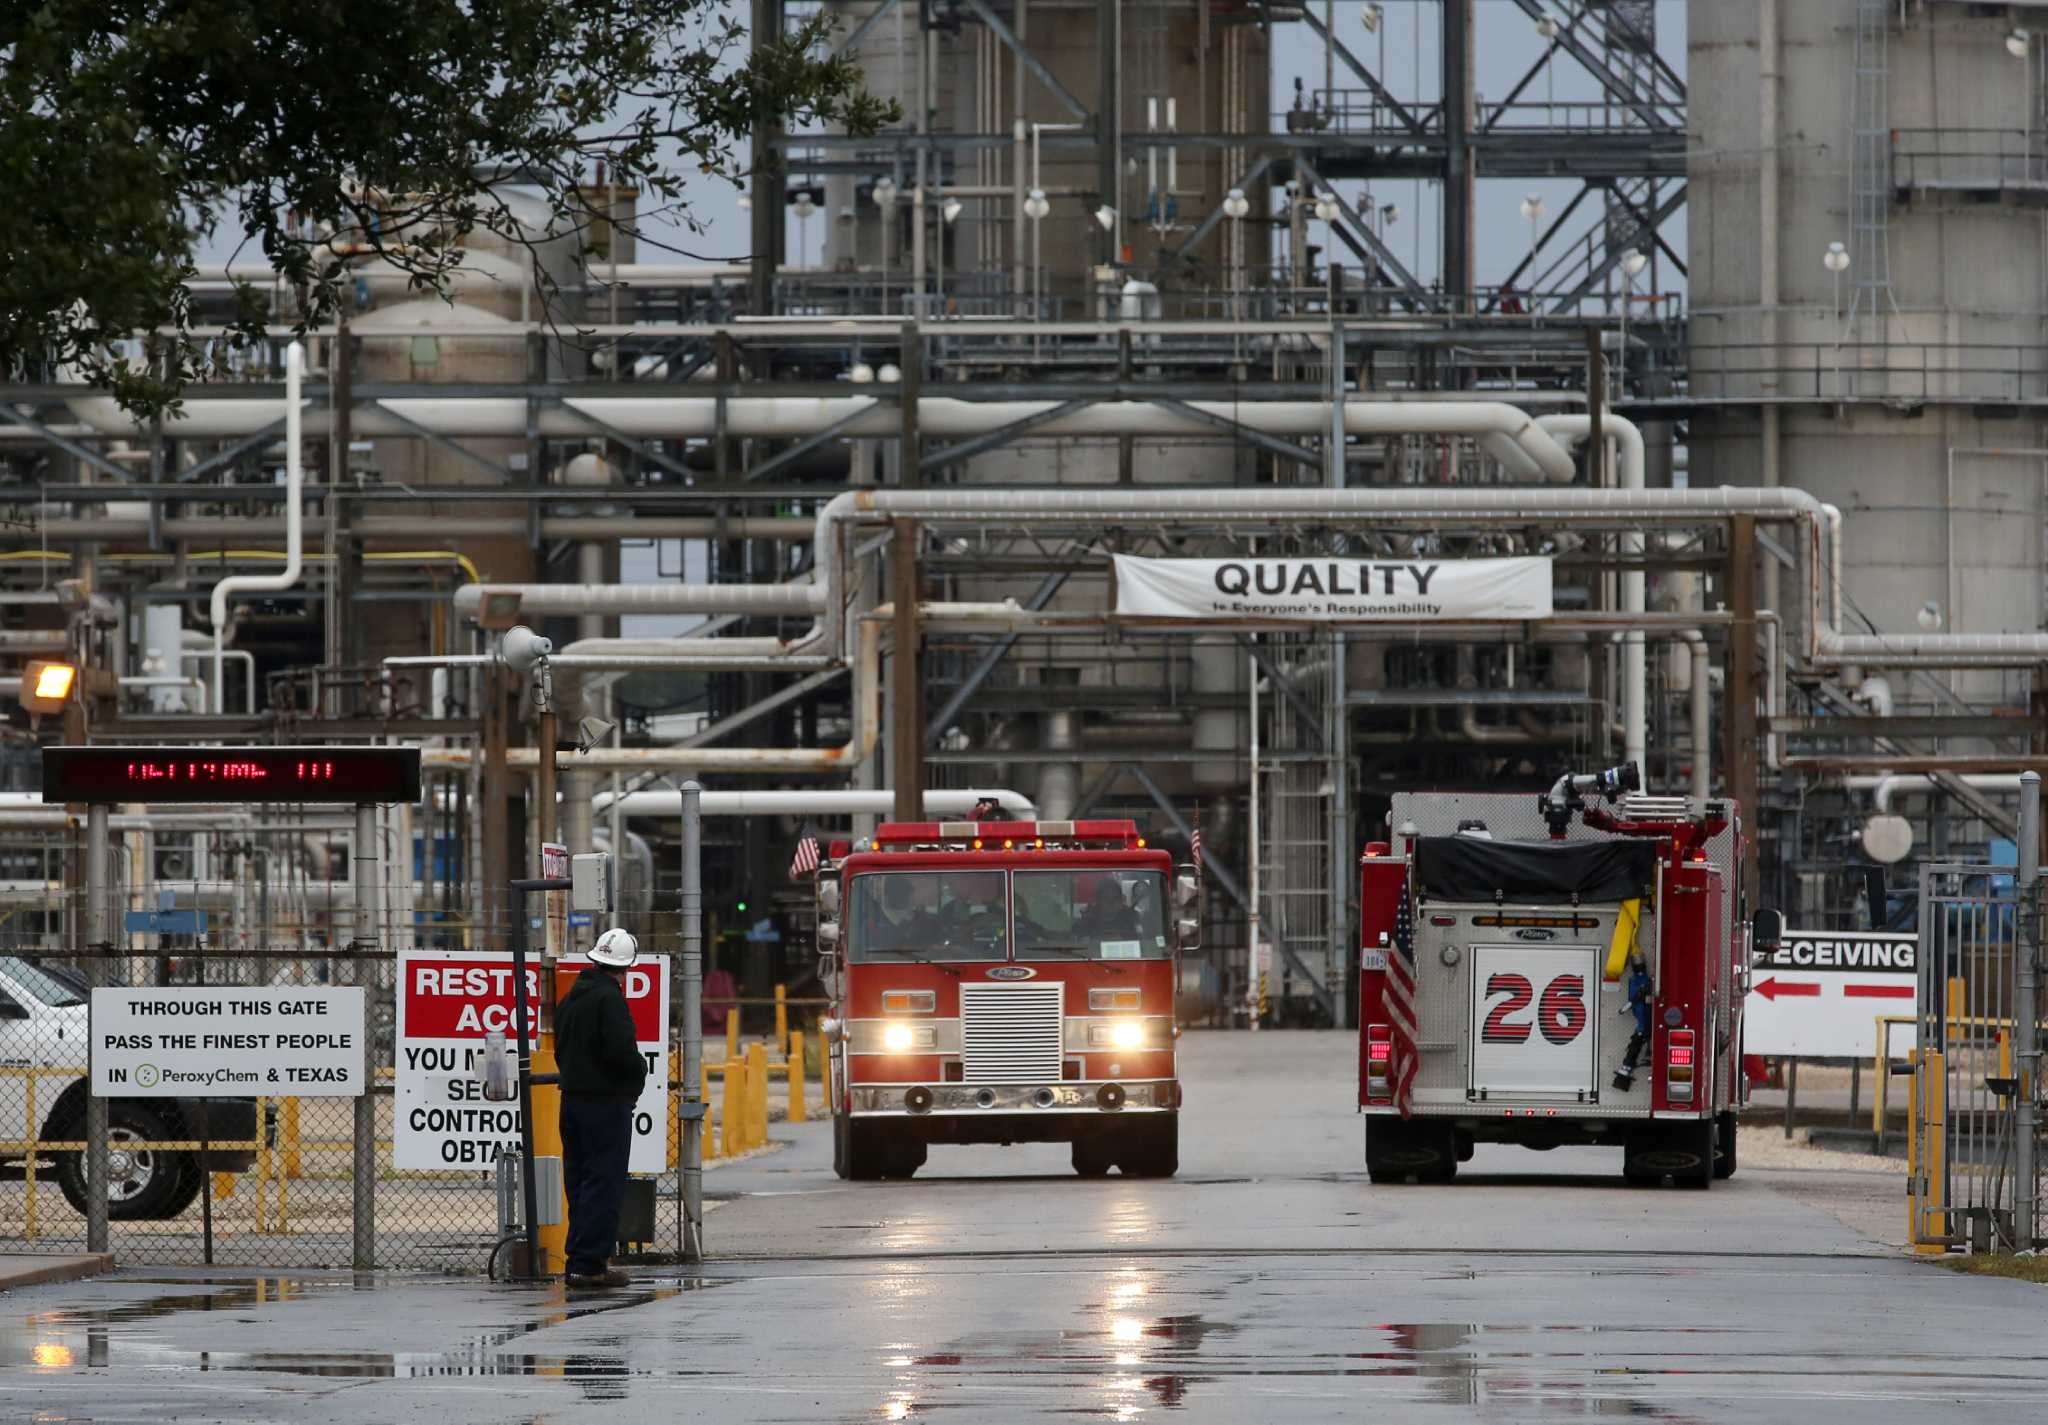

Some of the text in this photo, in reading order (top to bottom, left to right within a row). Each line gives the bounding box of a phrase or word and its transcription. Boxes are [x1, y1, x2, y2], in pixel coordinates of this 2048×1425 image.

[1215, 563, 1438, 597] QUALITY
[1232, 602, 1321, 614] Everyone's
[1327, 603, 1441, 615] Responsibility
[1752, 940, 1915, 967] ECEIVING
[416, 968, 650, 999] RESTRD
[128, 1001, 328, 1016] THROUGH THIS GATE
[1481, 972, 1586, 1045] 26
[104, 1035, 352, 1050] PASS THE FINEST PEOPLE
[405, 1047, 456, 1072] YOU
[108, 1068, 348, 1086] IN PeroxyChem & TEXAS
[441, 1139, 523, 1163] OBTA
